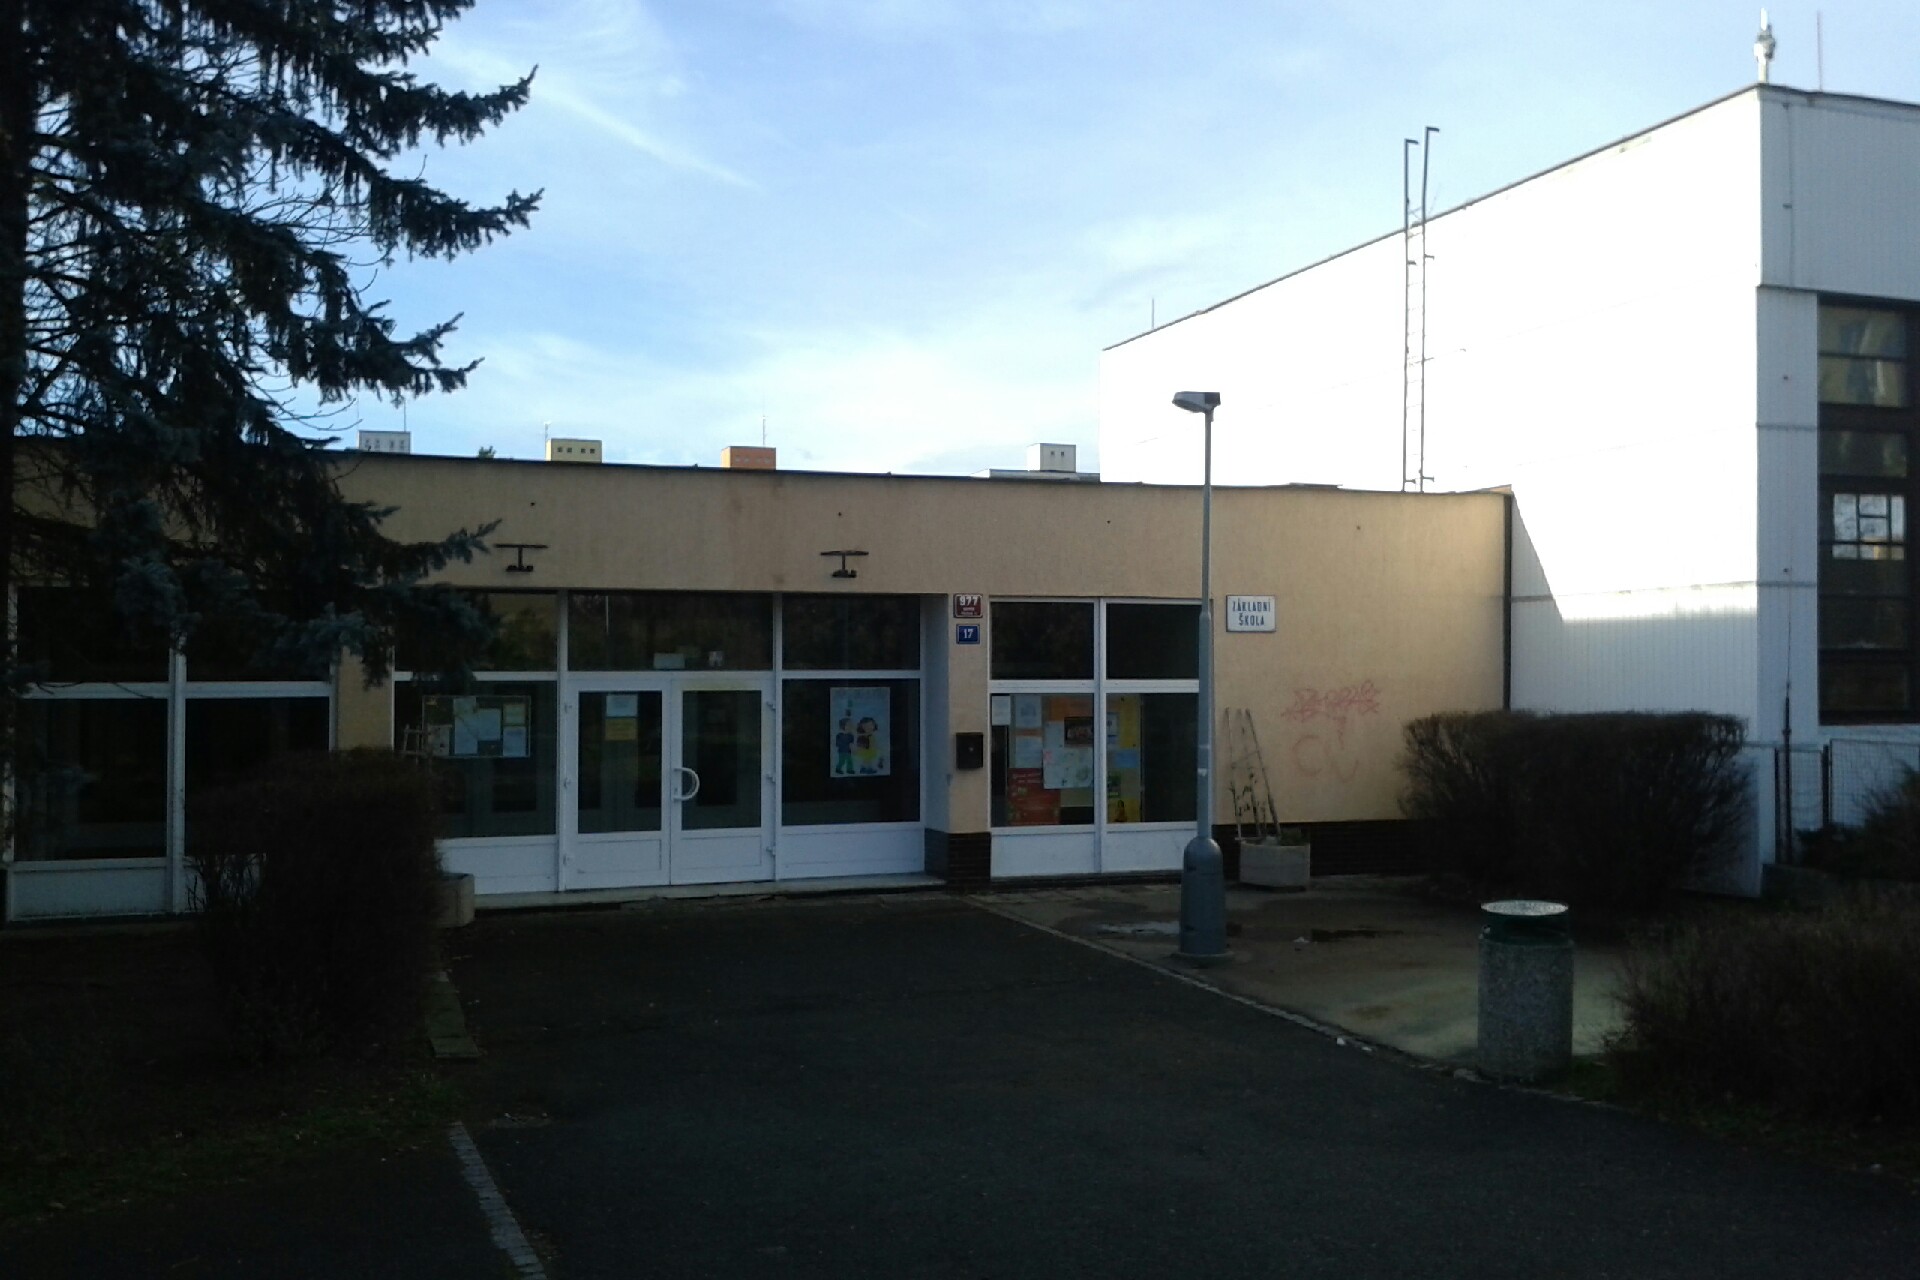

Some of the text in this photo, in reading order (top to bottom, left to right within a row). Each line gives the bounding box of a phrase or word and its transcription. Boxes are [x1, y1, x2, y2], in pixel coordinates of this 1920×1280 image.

[959, 595, 978, 606] 977
[1232, 598, 1271, 612] ZÁKLADNÍ
[1238, 612, 1265, 626] ŠKOLA
[963, 628, 974, 639] 17
